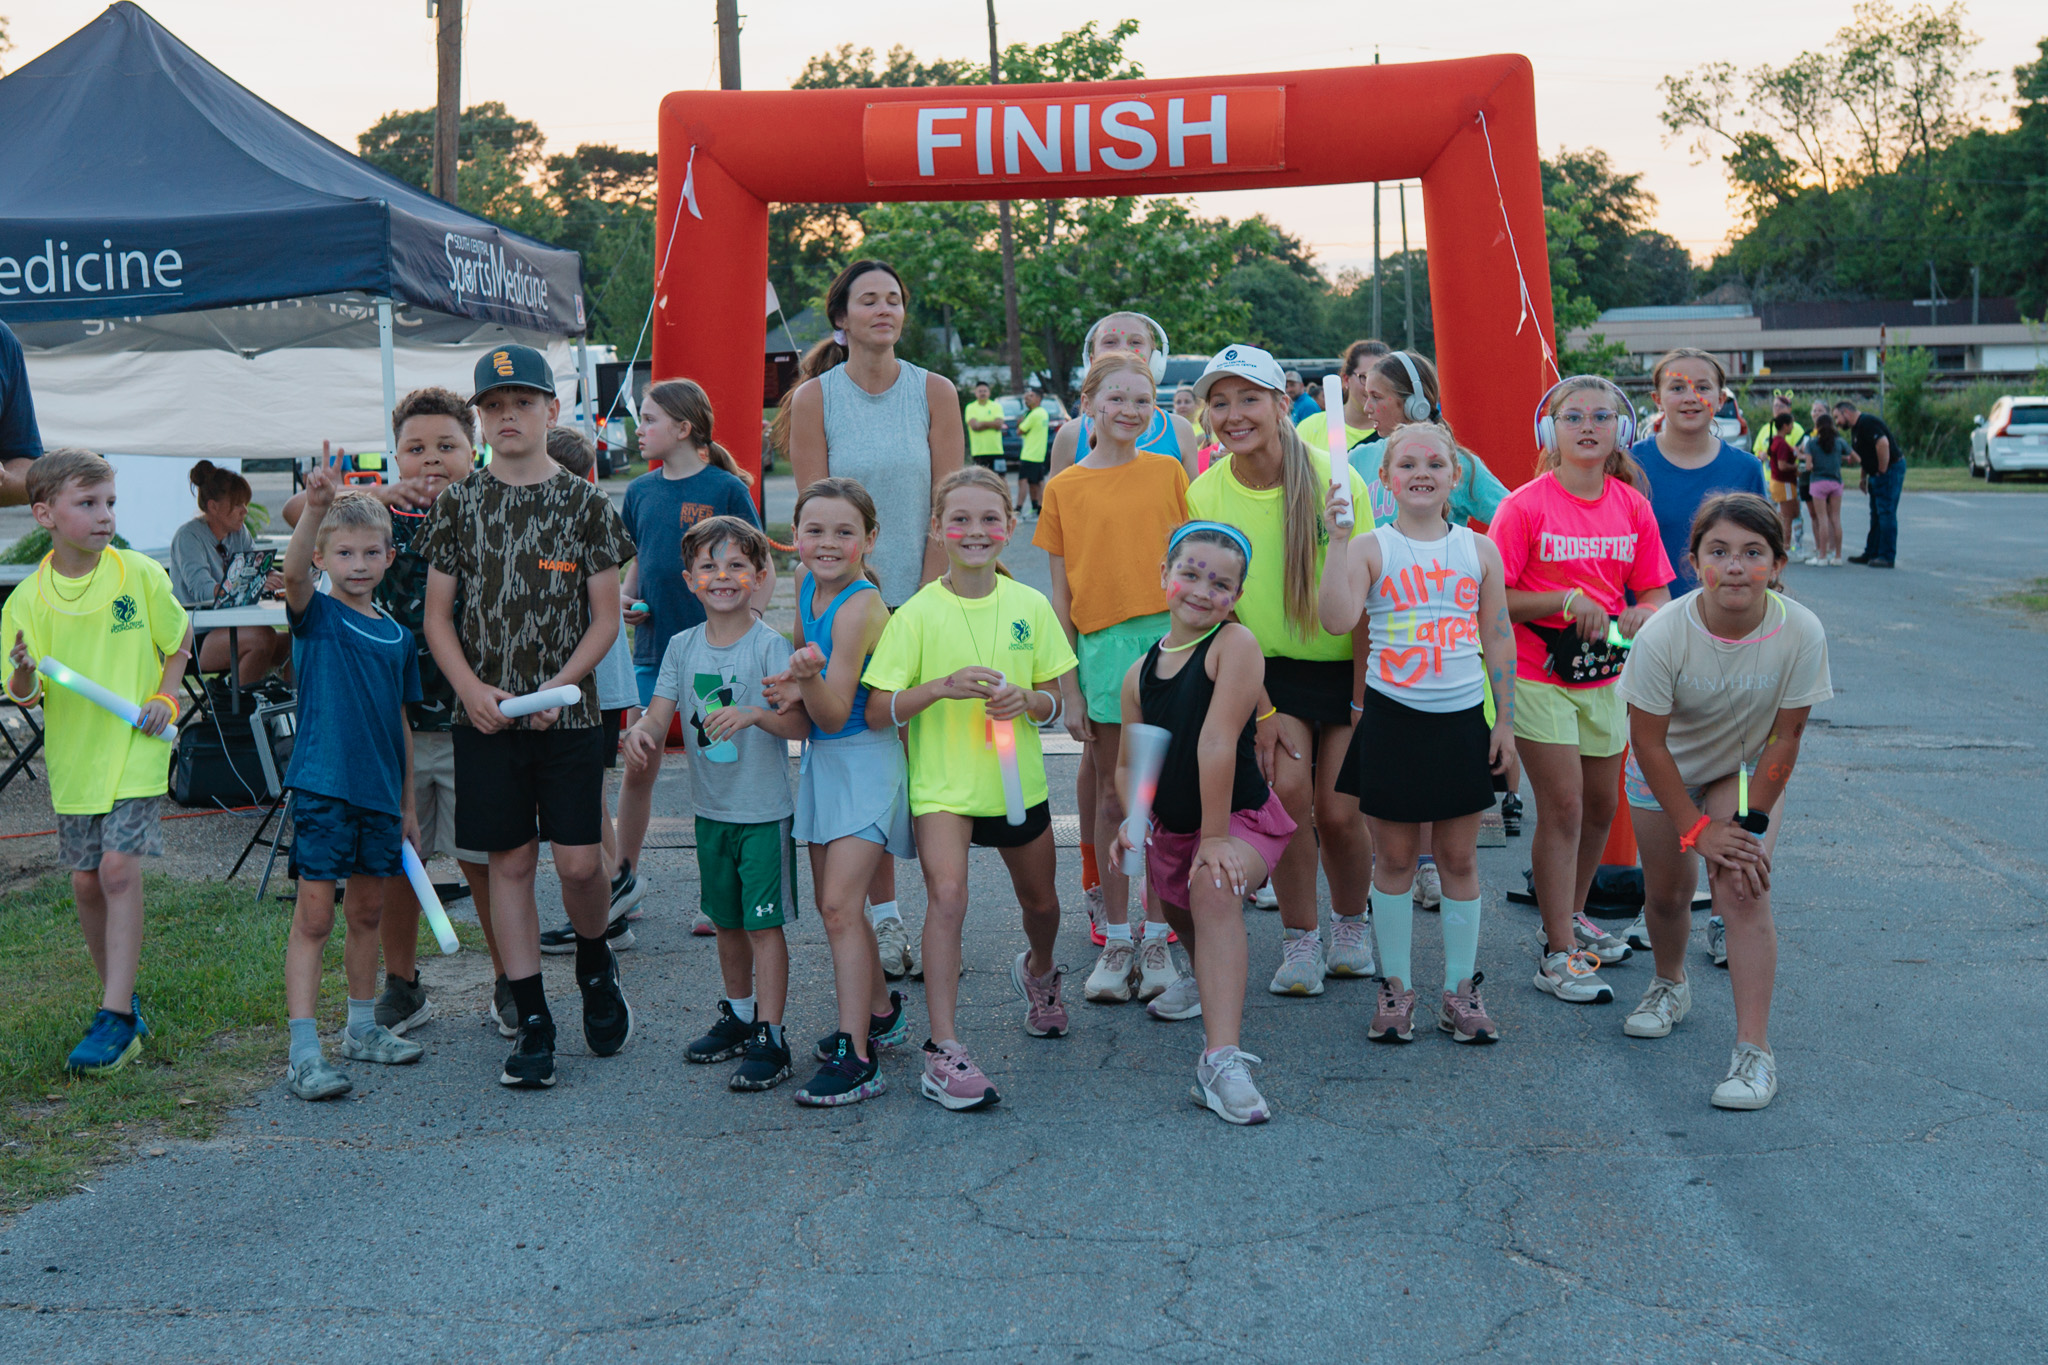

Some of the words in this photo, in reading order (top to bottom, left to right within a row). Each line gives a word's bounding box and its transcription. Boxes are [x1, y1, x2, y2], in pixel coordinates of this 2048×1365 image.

[917, 95, 1228, 176] FINISH
[1540, 531, 1638, 564] CROSSFIRE
[538, 558, 577, 573] HARDY
[1677, 671, 1780, 691] PANTHERS
